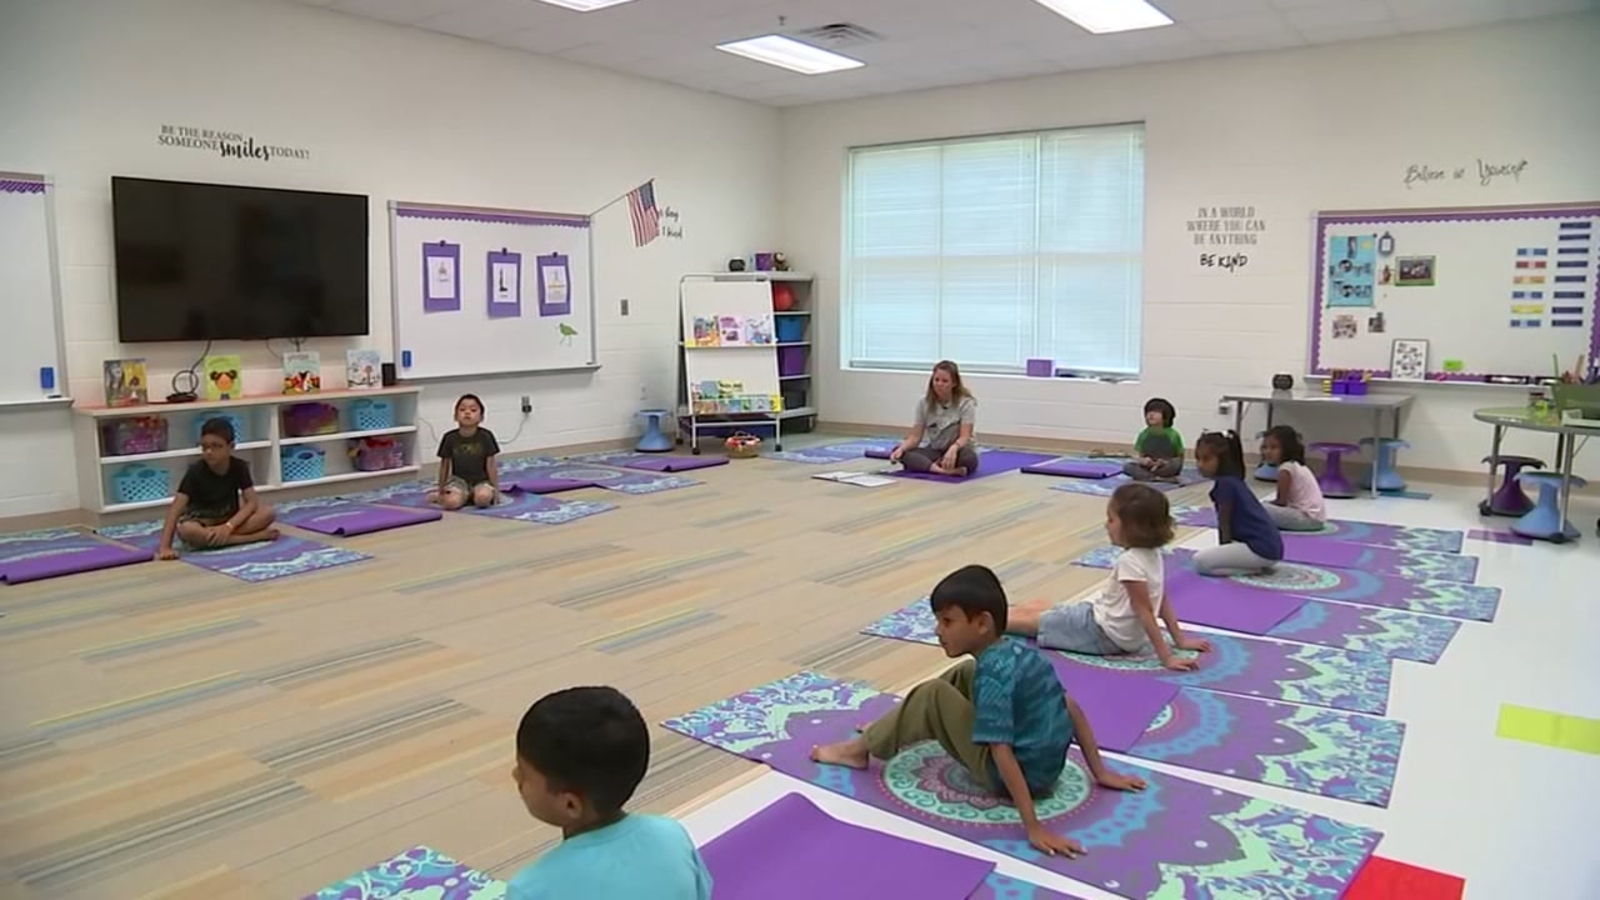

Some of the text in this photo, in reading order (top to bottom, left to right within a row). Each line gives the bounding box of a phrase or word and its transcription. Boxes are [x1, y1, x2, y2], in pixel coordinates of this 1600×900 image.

[178, 126, 199, 138] THE
[202, 129, 243, 142] REASON
[158, 135, 310, 161] SOMEONE smiles TODAY!
[1220, 206, 1255, 218] WORLD
[1187, 220, 1220, 231] WHERE
[1245, 220, 1266, 231] CAN
[1209, 233, 1257, 245] ANYTHING
[1200, 252, 1248, 273] BE KIND
